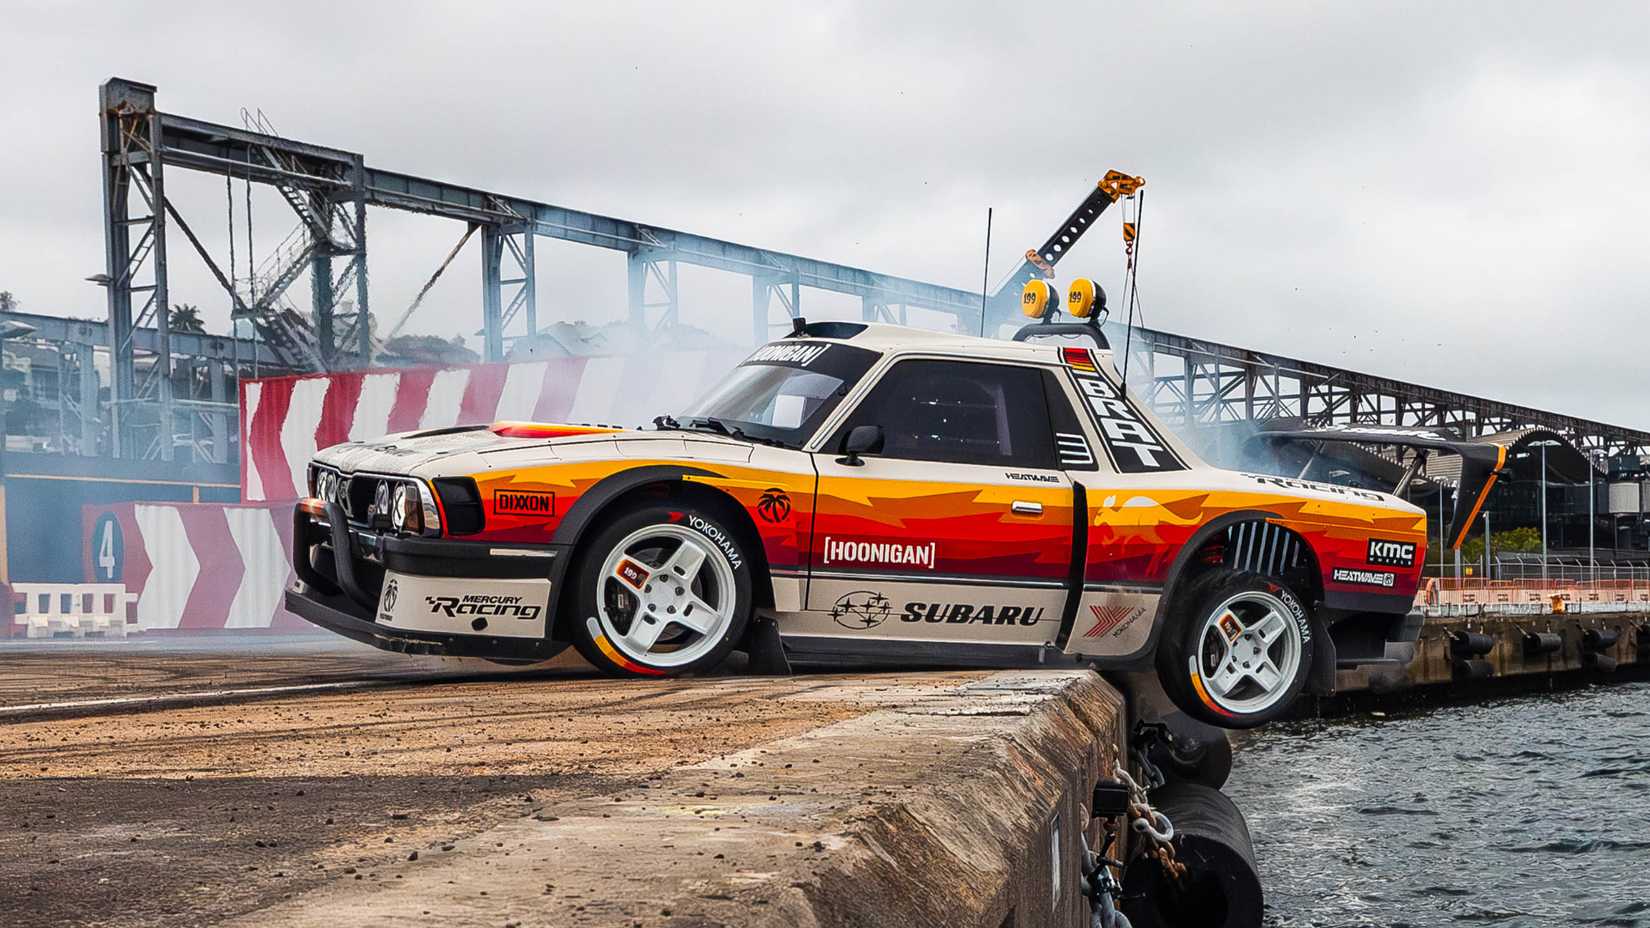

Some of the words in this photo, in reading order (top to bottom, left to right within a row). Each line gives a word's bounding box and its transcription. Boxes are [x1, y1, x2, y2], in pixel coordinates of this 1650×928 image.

[1077, 377, 1164, 467] BRAT
[499, 494, 549, 512] DIXXON
[99, 520, 115, 578] 4
[688, 514, 742, 570] YOKOHAMA
[823, 536, 936, 569] [HOONIGAN]
[1333, 569, 1384, 585] HEATWAVE
[462, 595, 523, 604] MERCURY
[900, 602, 1045, 626] SUBARU
[1280, 590, 1311, 643] YOKOHAMA
